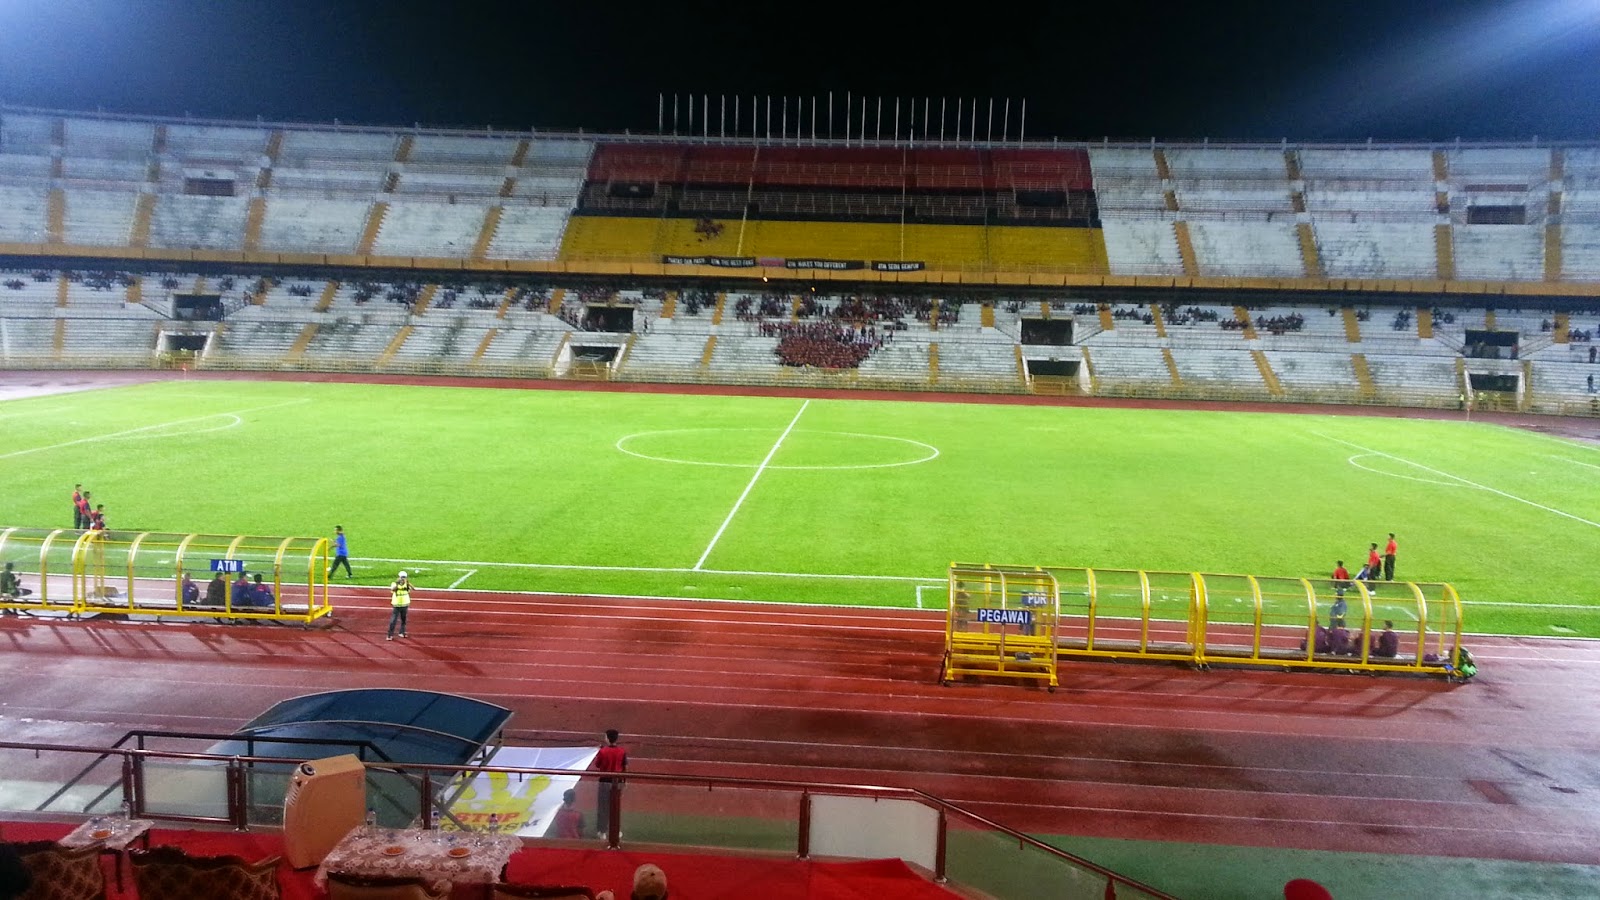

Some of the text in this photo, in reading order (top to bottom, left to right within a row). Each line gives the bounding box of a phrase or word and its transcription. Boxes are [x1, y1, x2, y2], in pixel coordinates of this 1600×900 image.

[823, 261, 847, 269] DIFFERENT
[216, 560, 238, 572] ATM
[1028, 592, 1054, 605] PDR
[979, 609, 1029, 624] PEGAWAI
[454, 811, 521, 823] STOP
